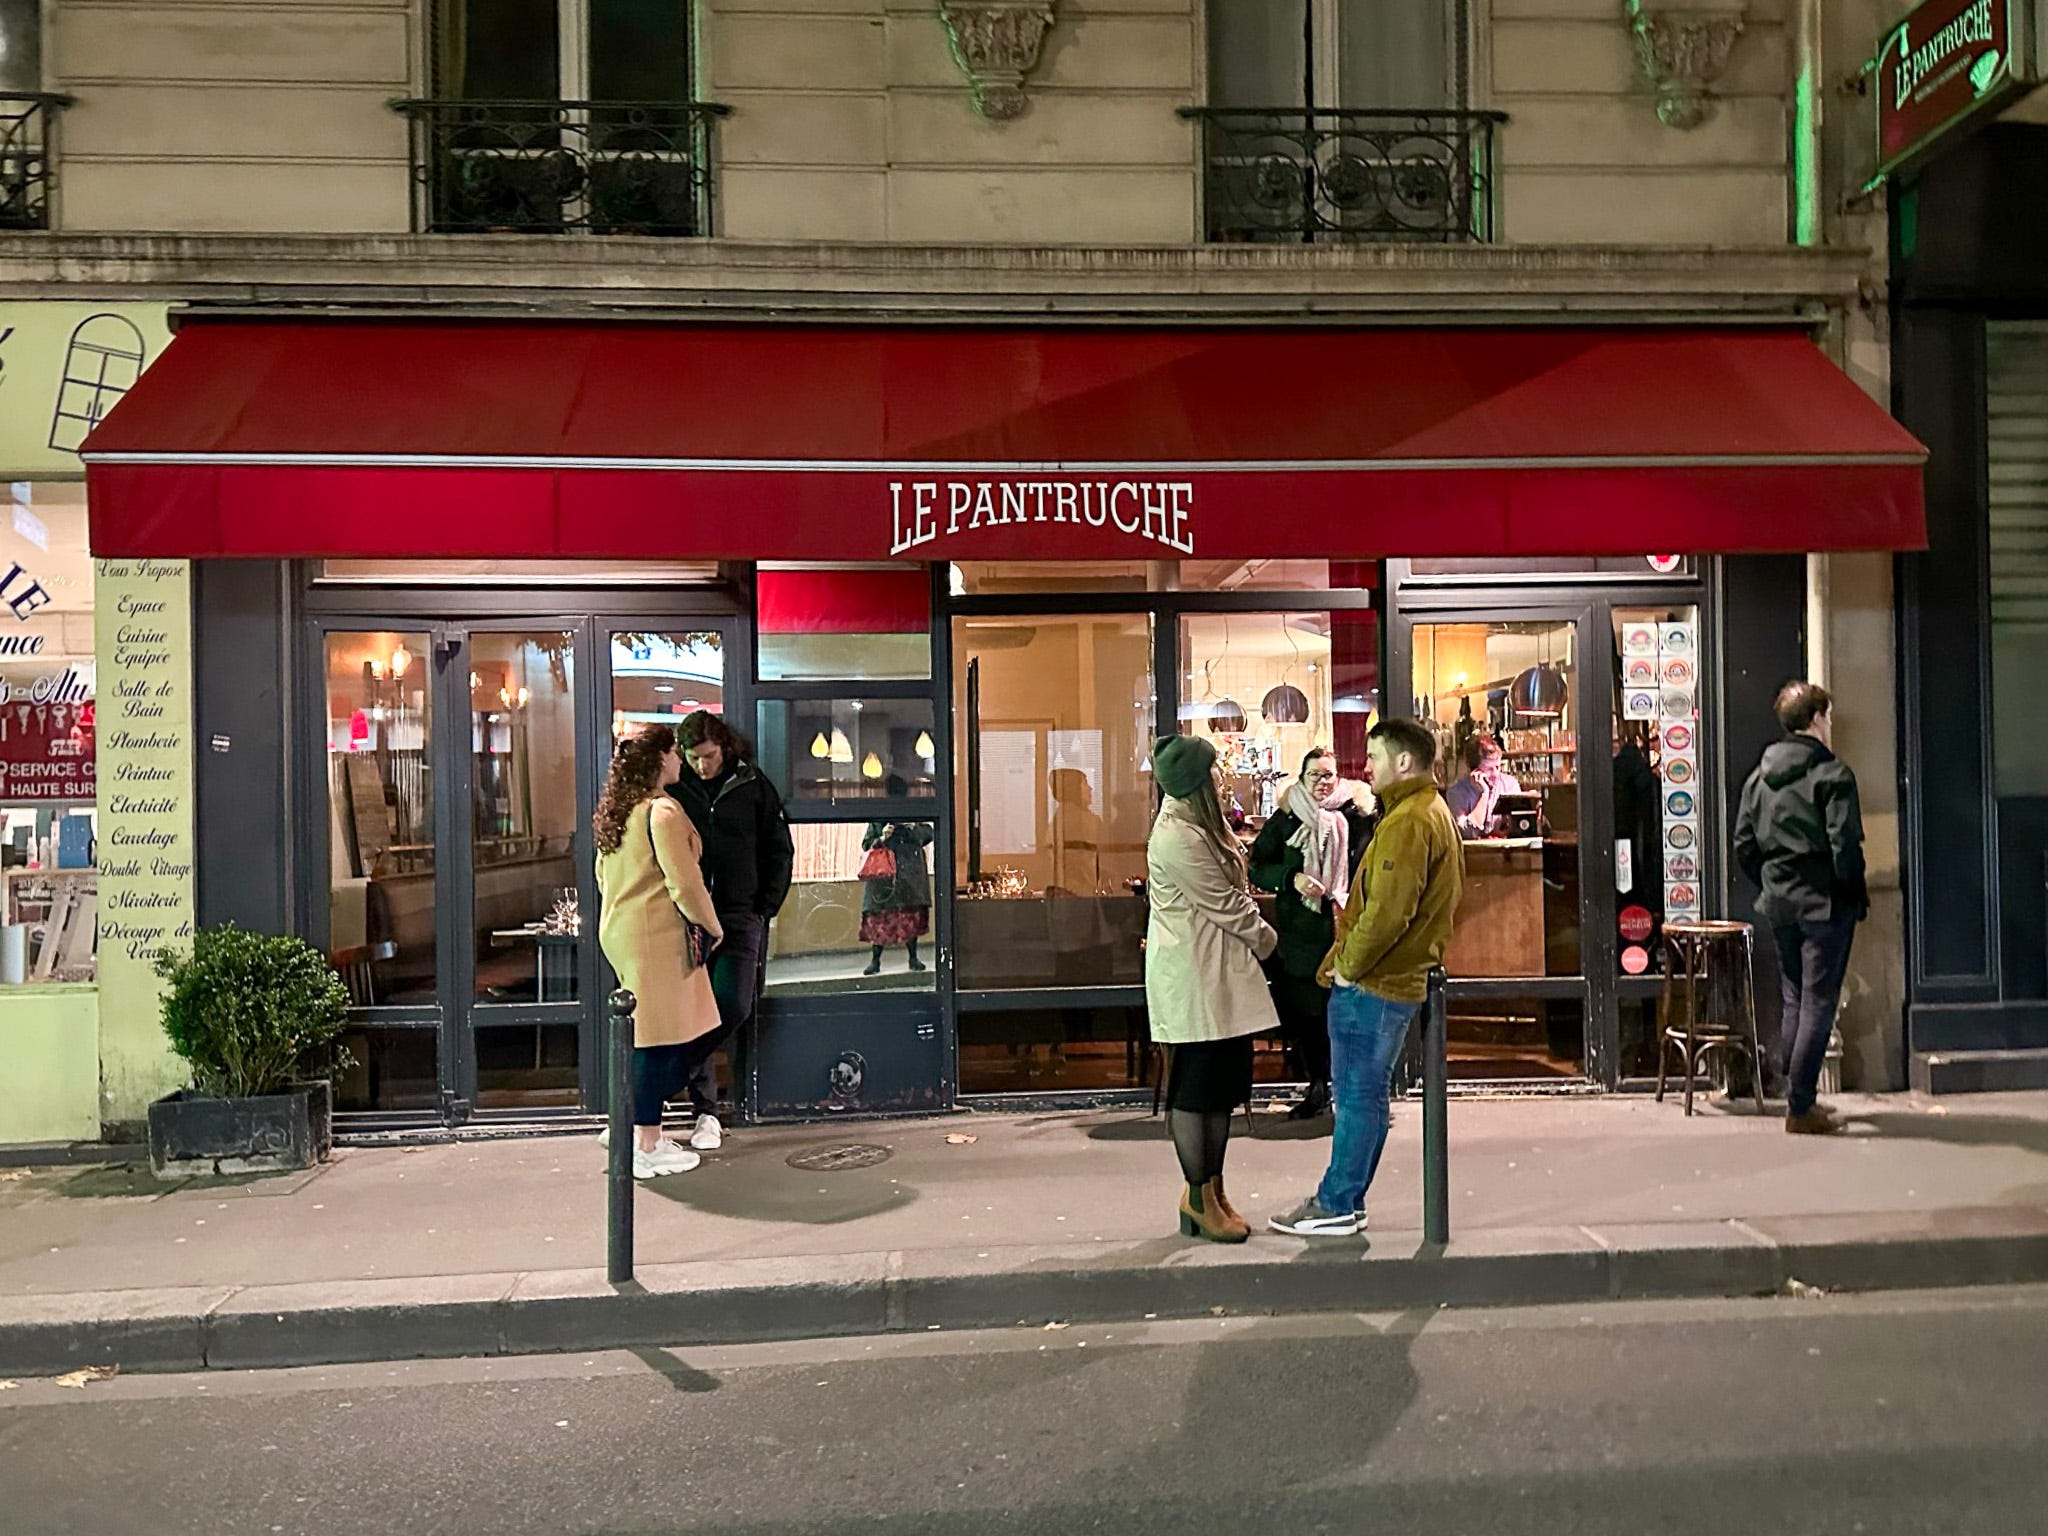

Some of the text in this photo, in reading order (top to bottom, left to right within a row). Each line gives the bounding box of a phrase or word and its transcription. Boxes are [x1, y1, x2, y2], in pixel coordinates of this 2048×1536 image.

[1895, 56, 1911, 111] LE
[1912, 0, 1993, 86] PANTRUCHE
[890, 481, 1194, 556] LE PANTRUCHE
[98, 558, 185, 583] Vous Propose
[117, 594, 167, 619] Espace
[117, 624, 169, 644] Cuisine
[0, 635, 44, 655] nce
[114, 645, 171, 670] Equipée
[111, 678, 174, 697] Salle de
[121, 700, 164, 718] Bain
[106, 730, 181, 750] Plomberie
[10, 762, 77, 777] SERVICE
[113, 761, 175, 781] Peinture
[10, 782, 61, 796] HAUTE
[110, 794, 179, 814] Electricité
[111, 825, 178, 850] Carrelage
[99, 856, 191, 881] Double Vitrage
[108, 889, 182, 910] Miroiterie
[100, 920, 192, 944] Découpe de
